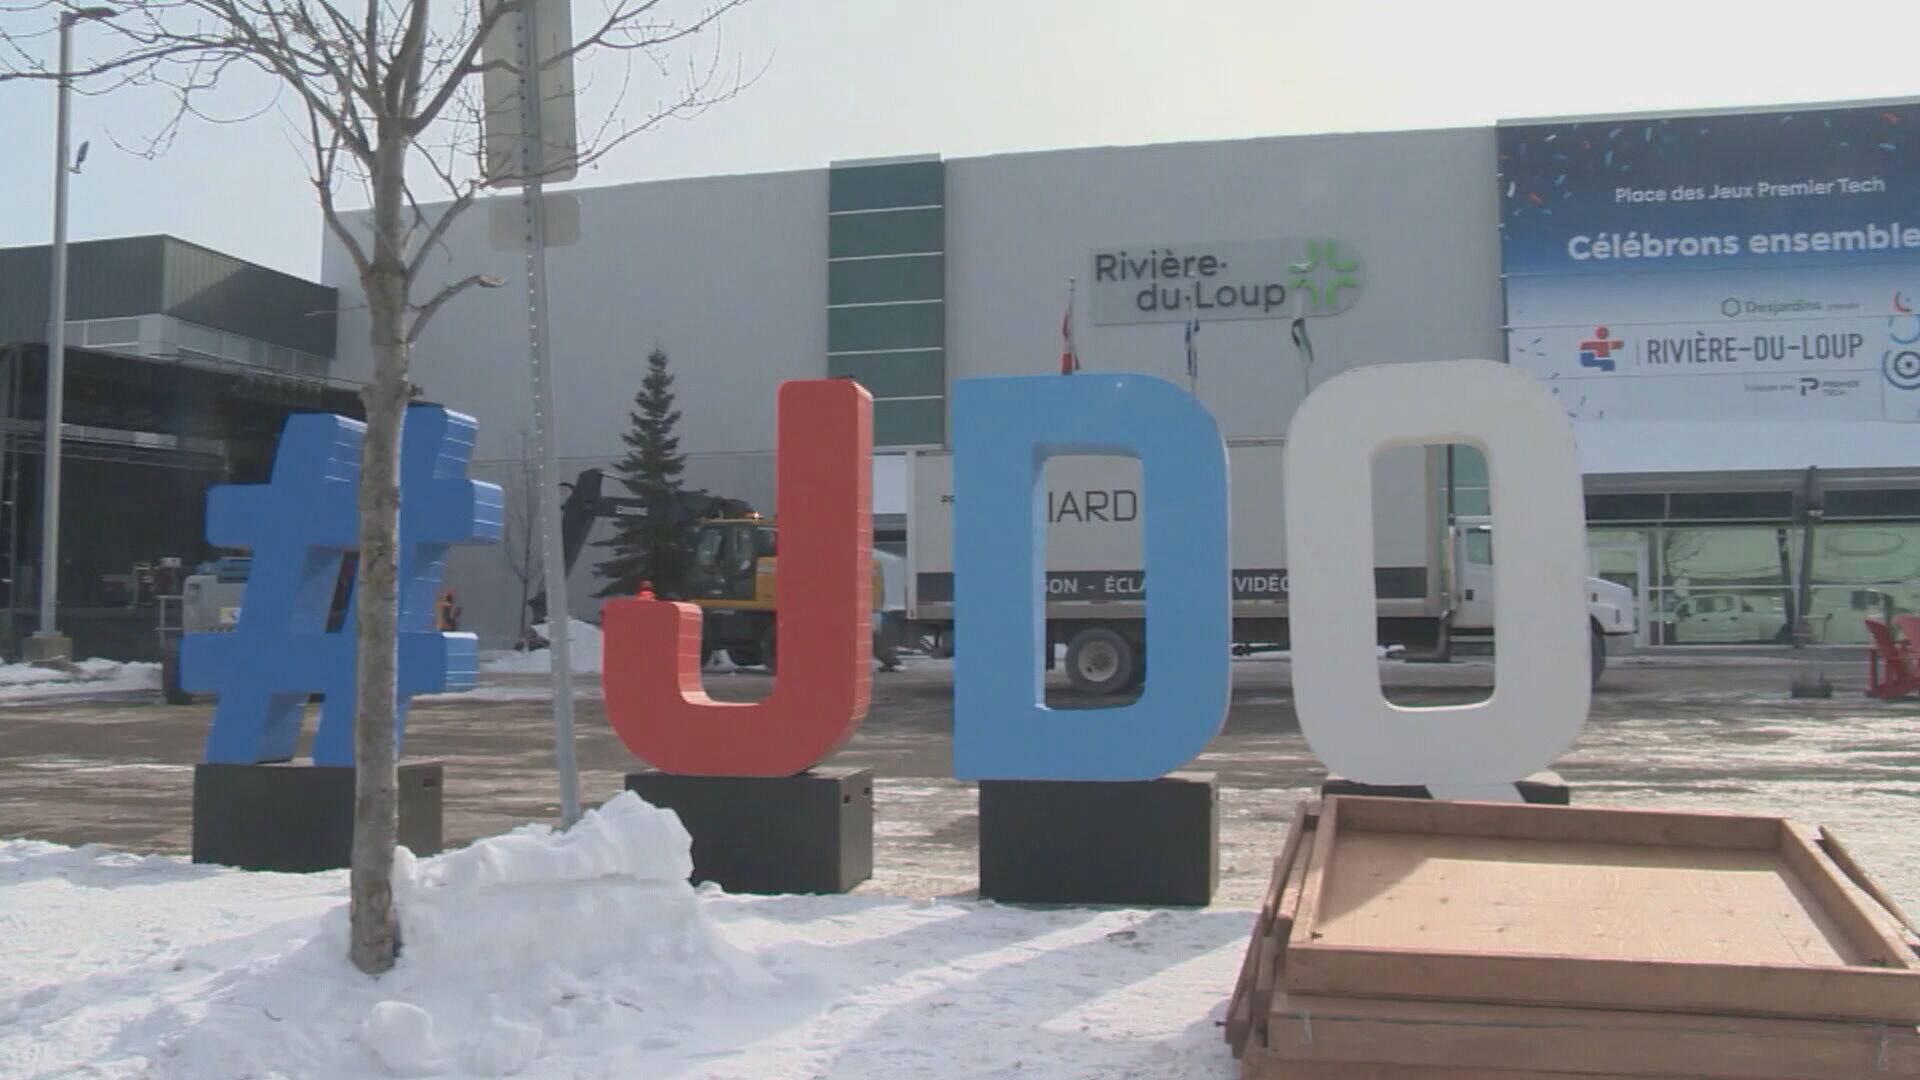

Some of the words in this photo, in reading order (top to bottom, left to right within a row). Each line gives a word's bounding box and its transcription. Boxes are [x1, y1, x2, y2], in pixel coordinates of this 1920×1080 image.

[1614, 186, 1667, 203] Place
[1671, 183, 1705, 201] des
[1708, 183, 1754, 200] Jeux
[1758, 179, 1833, 198] Premier
[1837, 176, 1886, 194] Tech
[1567, 231, 1740, 261] Célébrons
[1749, 221, 1920, 254] ensemble
[1647, 330, 1864, 365] RIVIÈRE-DU-LOUP
